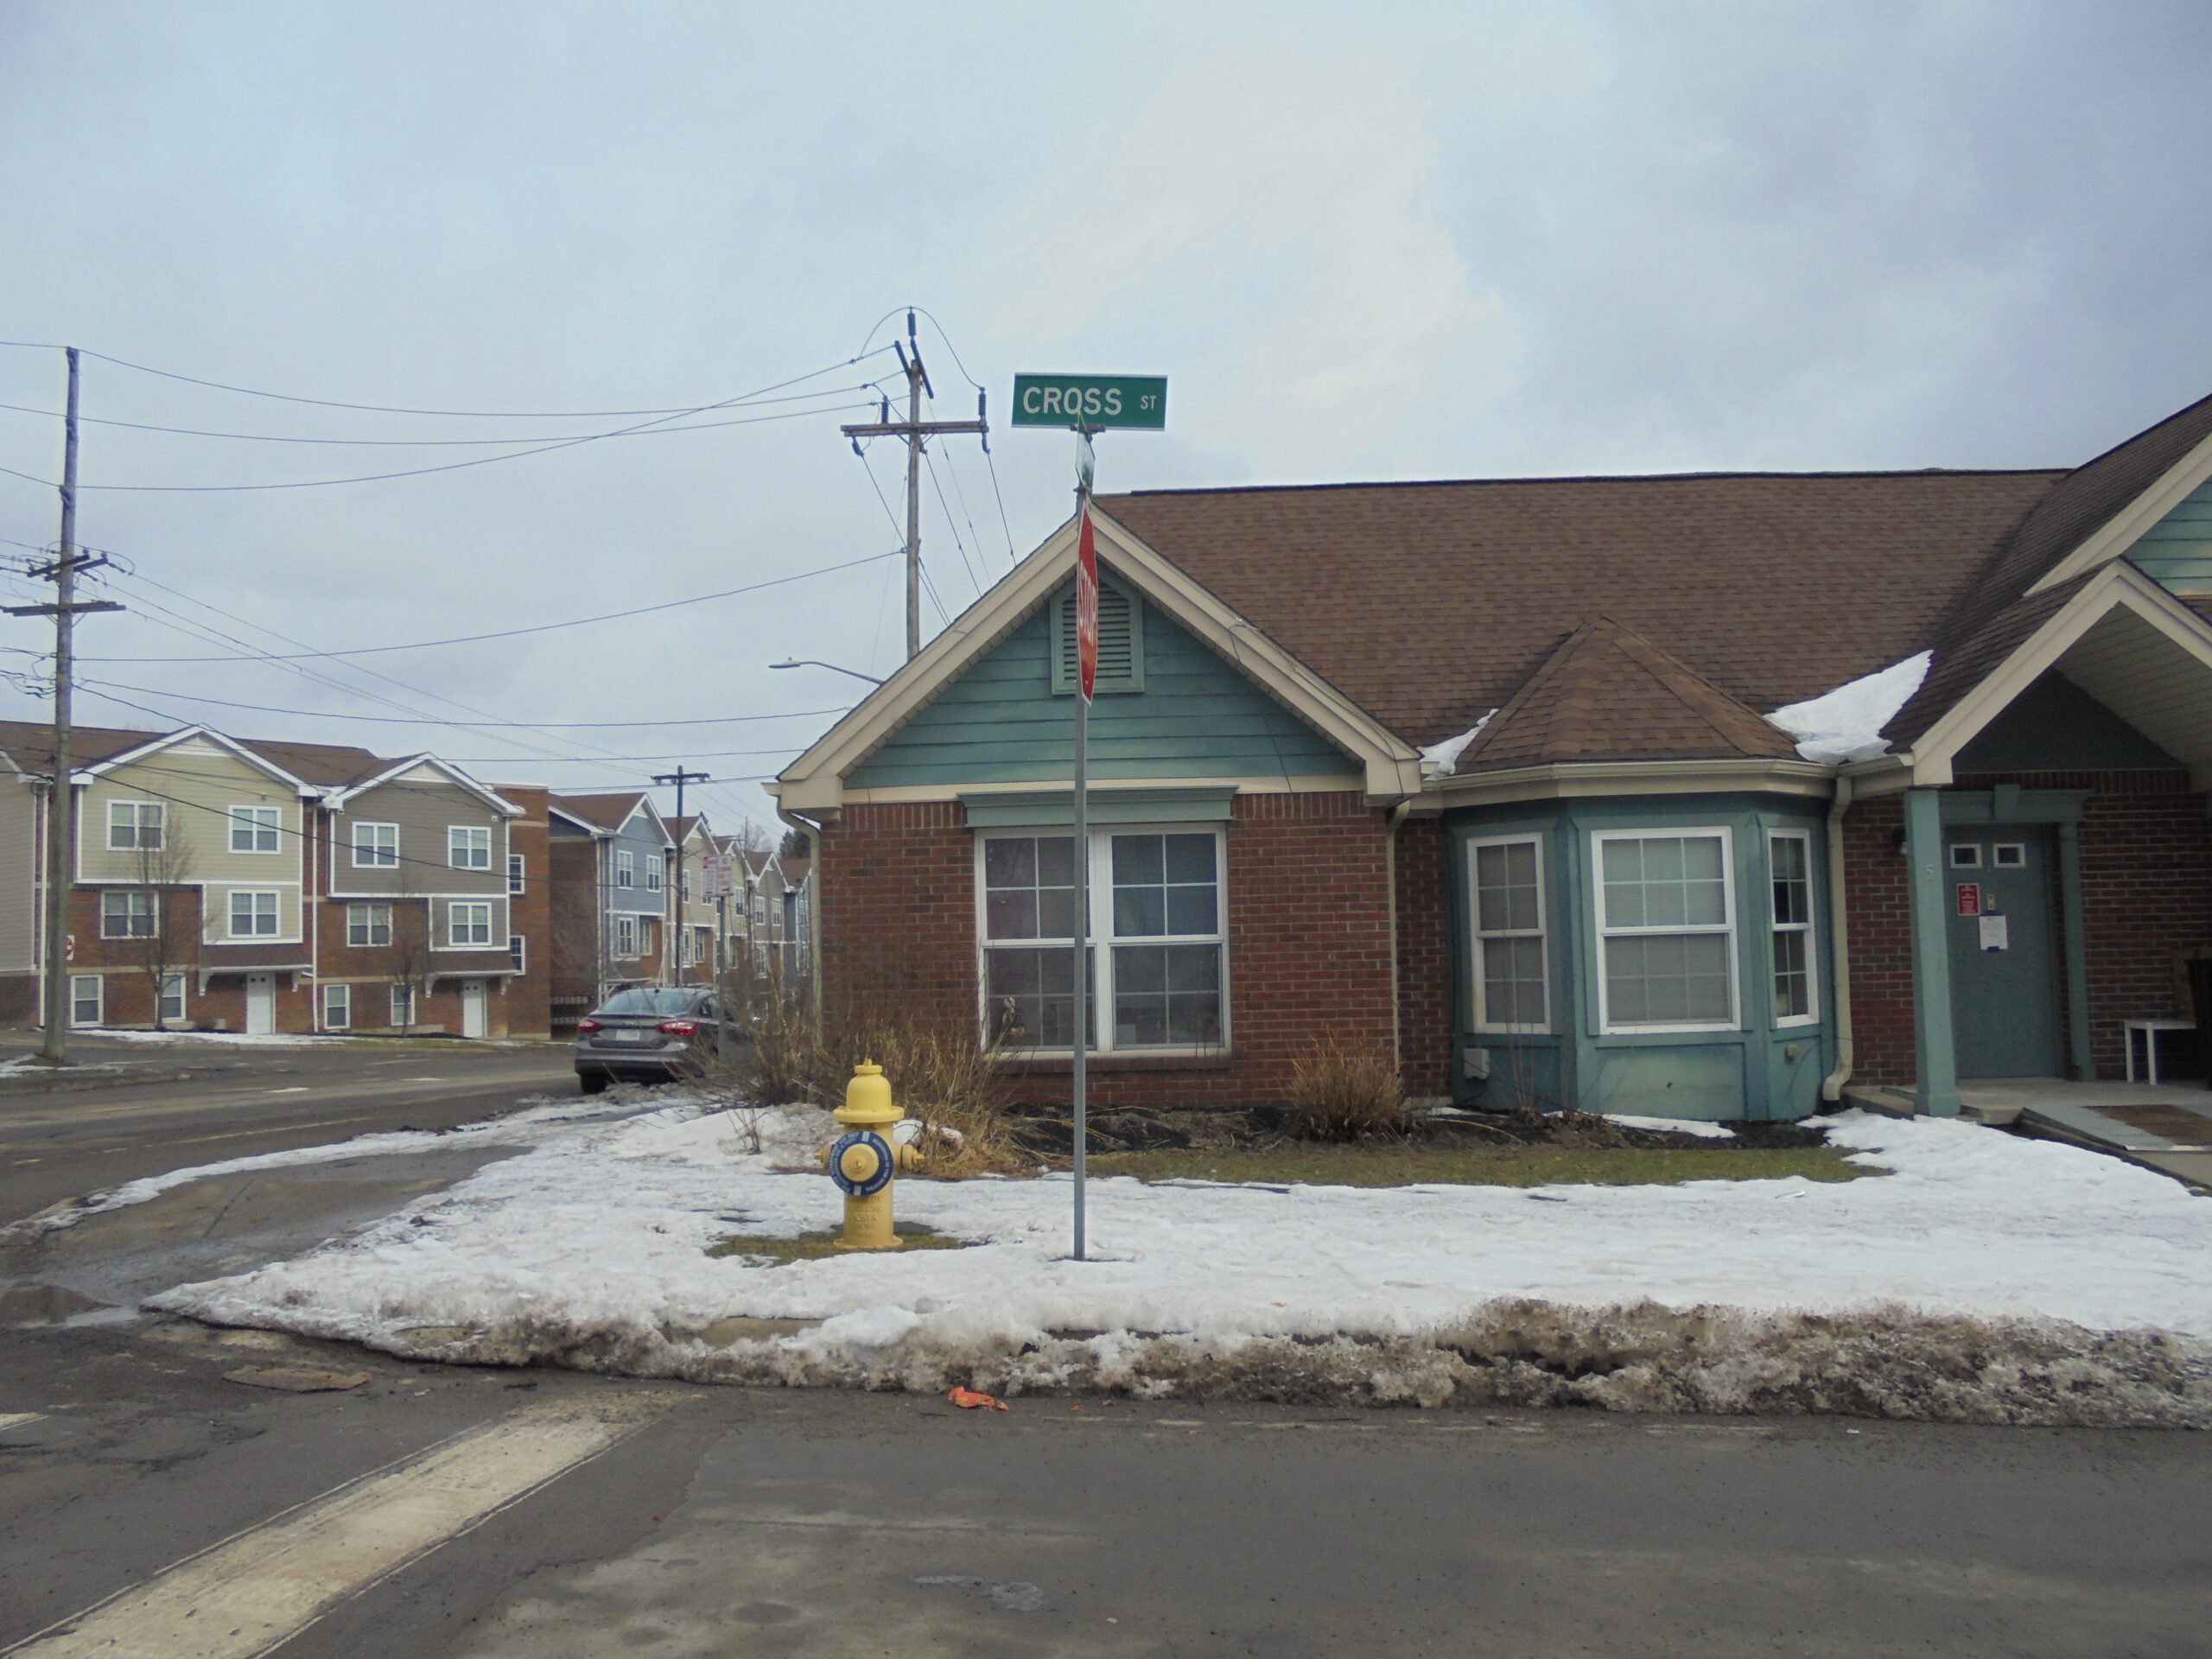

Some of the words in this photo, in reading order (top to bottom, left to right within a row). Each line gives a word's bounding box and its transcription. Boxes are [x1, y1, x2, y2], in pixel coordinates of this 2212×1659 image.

[1022, 386, 1122, 416] CROSS
[1140, 395, 1157, 410] ST
[1078, 558, 1097, 647] STOP
